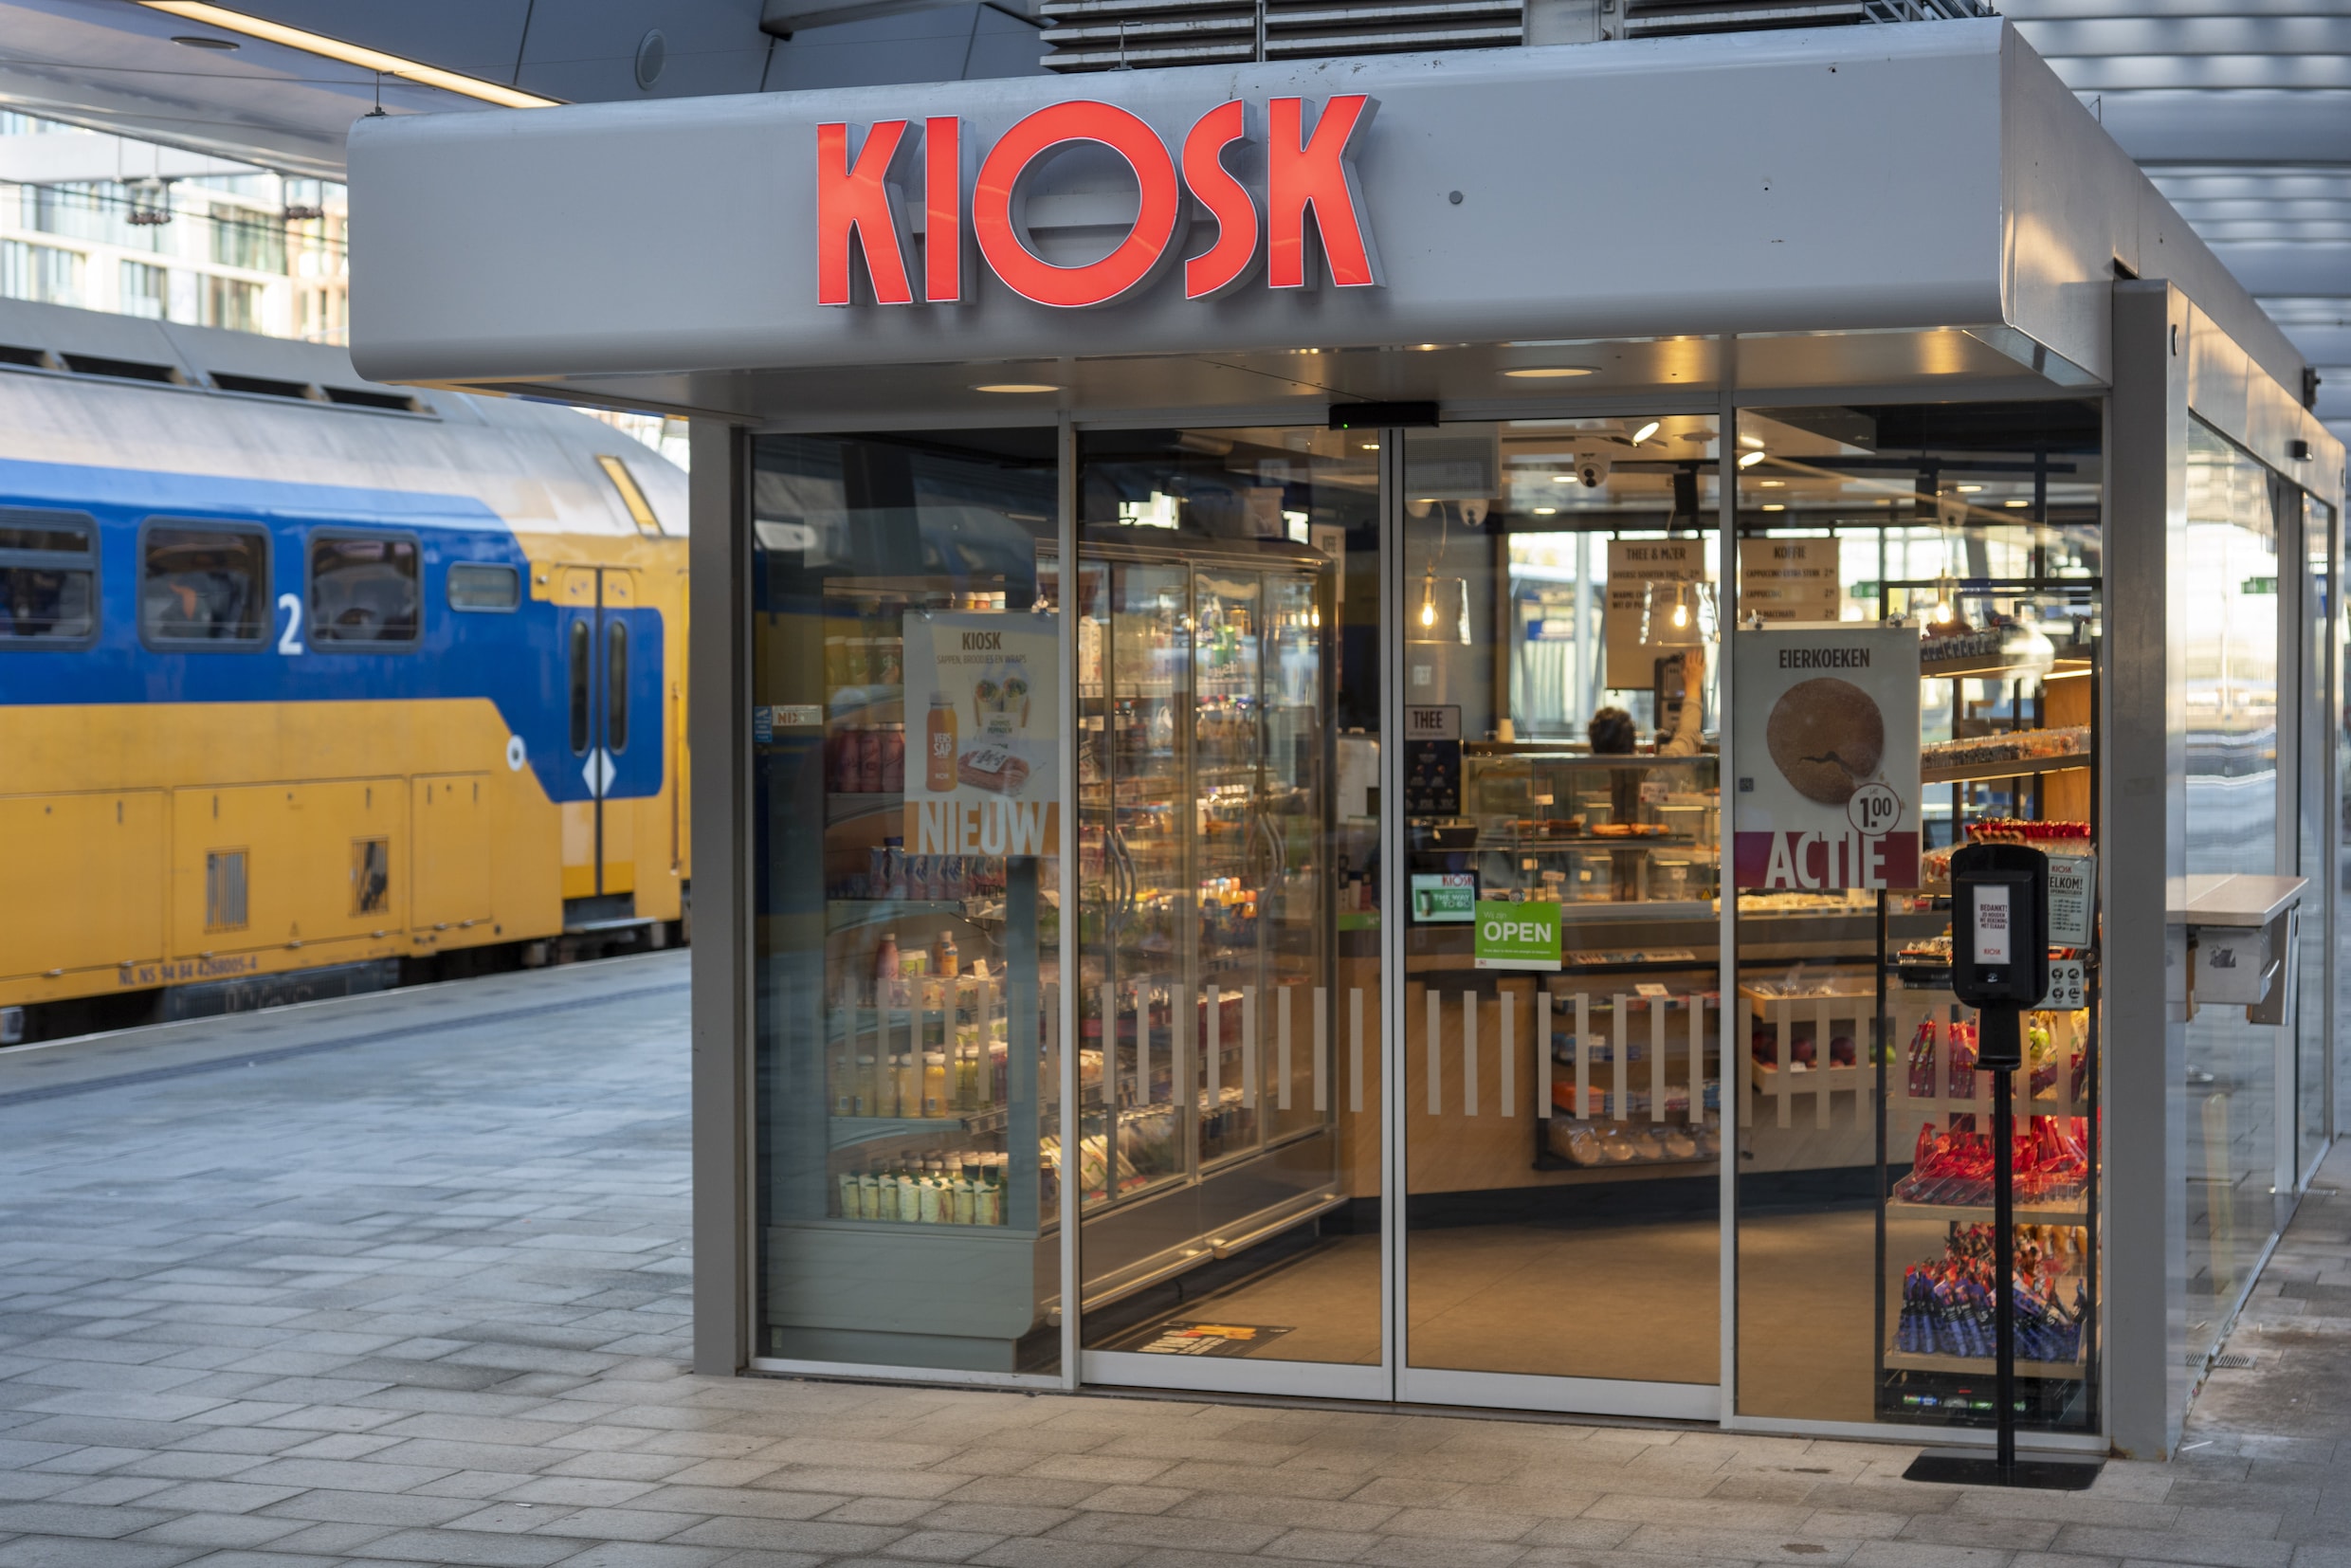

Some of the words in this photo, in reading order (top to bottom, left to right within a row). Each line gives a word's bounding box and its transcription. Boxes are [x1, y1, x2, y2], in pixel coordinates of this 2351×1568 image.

[816, 93, 1380, 308] KIOSK
[1626, 548, 1648, 560] THEE
[1651, 548, 1658, 560] &
[1661, 548, 1686, 560] MEER
[1774, 546, 1805, 559] KOFFIE
[278, 593, 302, 655] 2
[962, 632, 1001, 650] KIOSK
[937, 655, 962, 665] SAPPEN,
[995, 654, 1004, 664] EN
[1005, 654, 1027, 664] WRAPS
[1778, 648, 1870, 668] EIERKOEKEN
[1413, 711, 1443, 729] THEE
[934, 733, 952, 743] VERS
[934, 742, 952, 757] SAP
[1860, 797, 1892, 828] 1.00
[919, 801, 1048, 855] NIEUW
[1764, 831, 1887, 888] ACTIE
[2051, 865, 2072, 873] KIOSK
[1442, 874, 1474, 887] KIOSK
[2049, 876, 2084, 890] ELKOM!
[1484, 911, 1495, 920] Wij
[1484, 921, 1552, 942] OPEN
